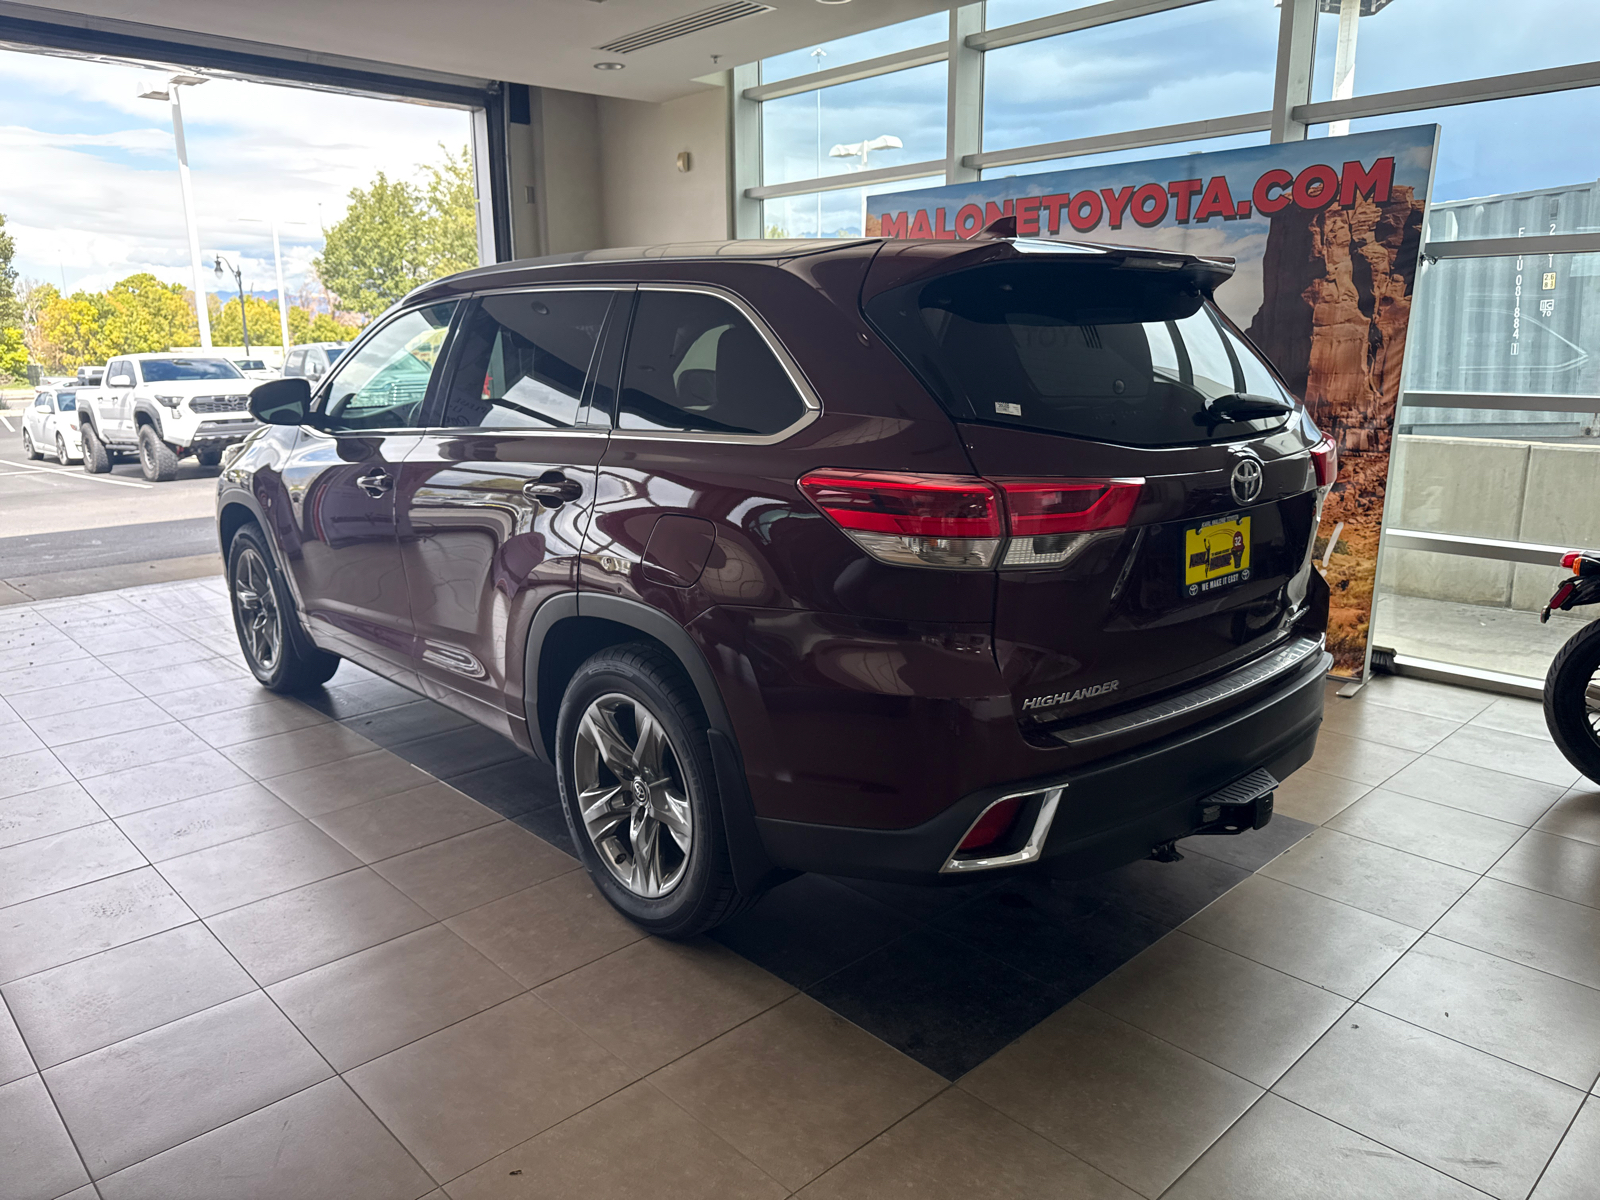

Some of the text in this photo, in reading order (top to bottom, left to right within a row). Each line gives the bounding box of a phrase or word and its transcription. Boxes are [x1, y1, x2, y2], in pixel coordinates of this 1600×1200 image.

[1512, 274, 1523, 340] 081884
[1234, 536, 1242, 547] 32
[1201, 573, 1239, 591] WE MAKE IT EASY
[1021, 679, 1120, 711] HIGHLANDER
